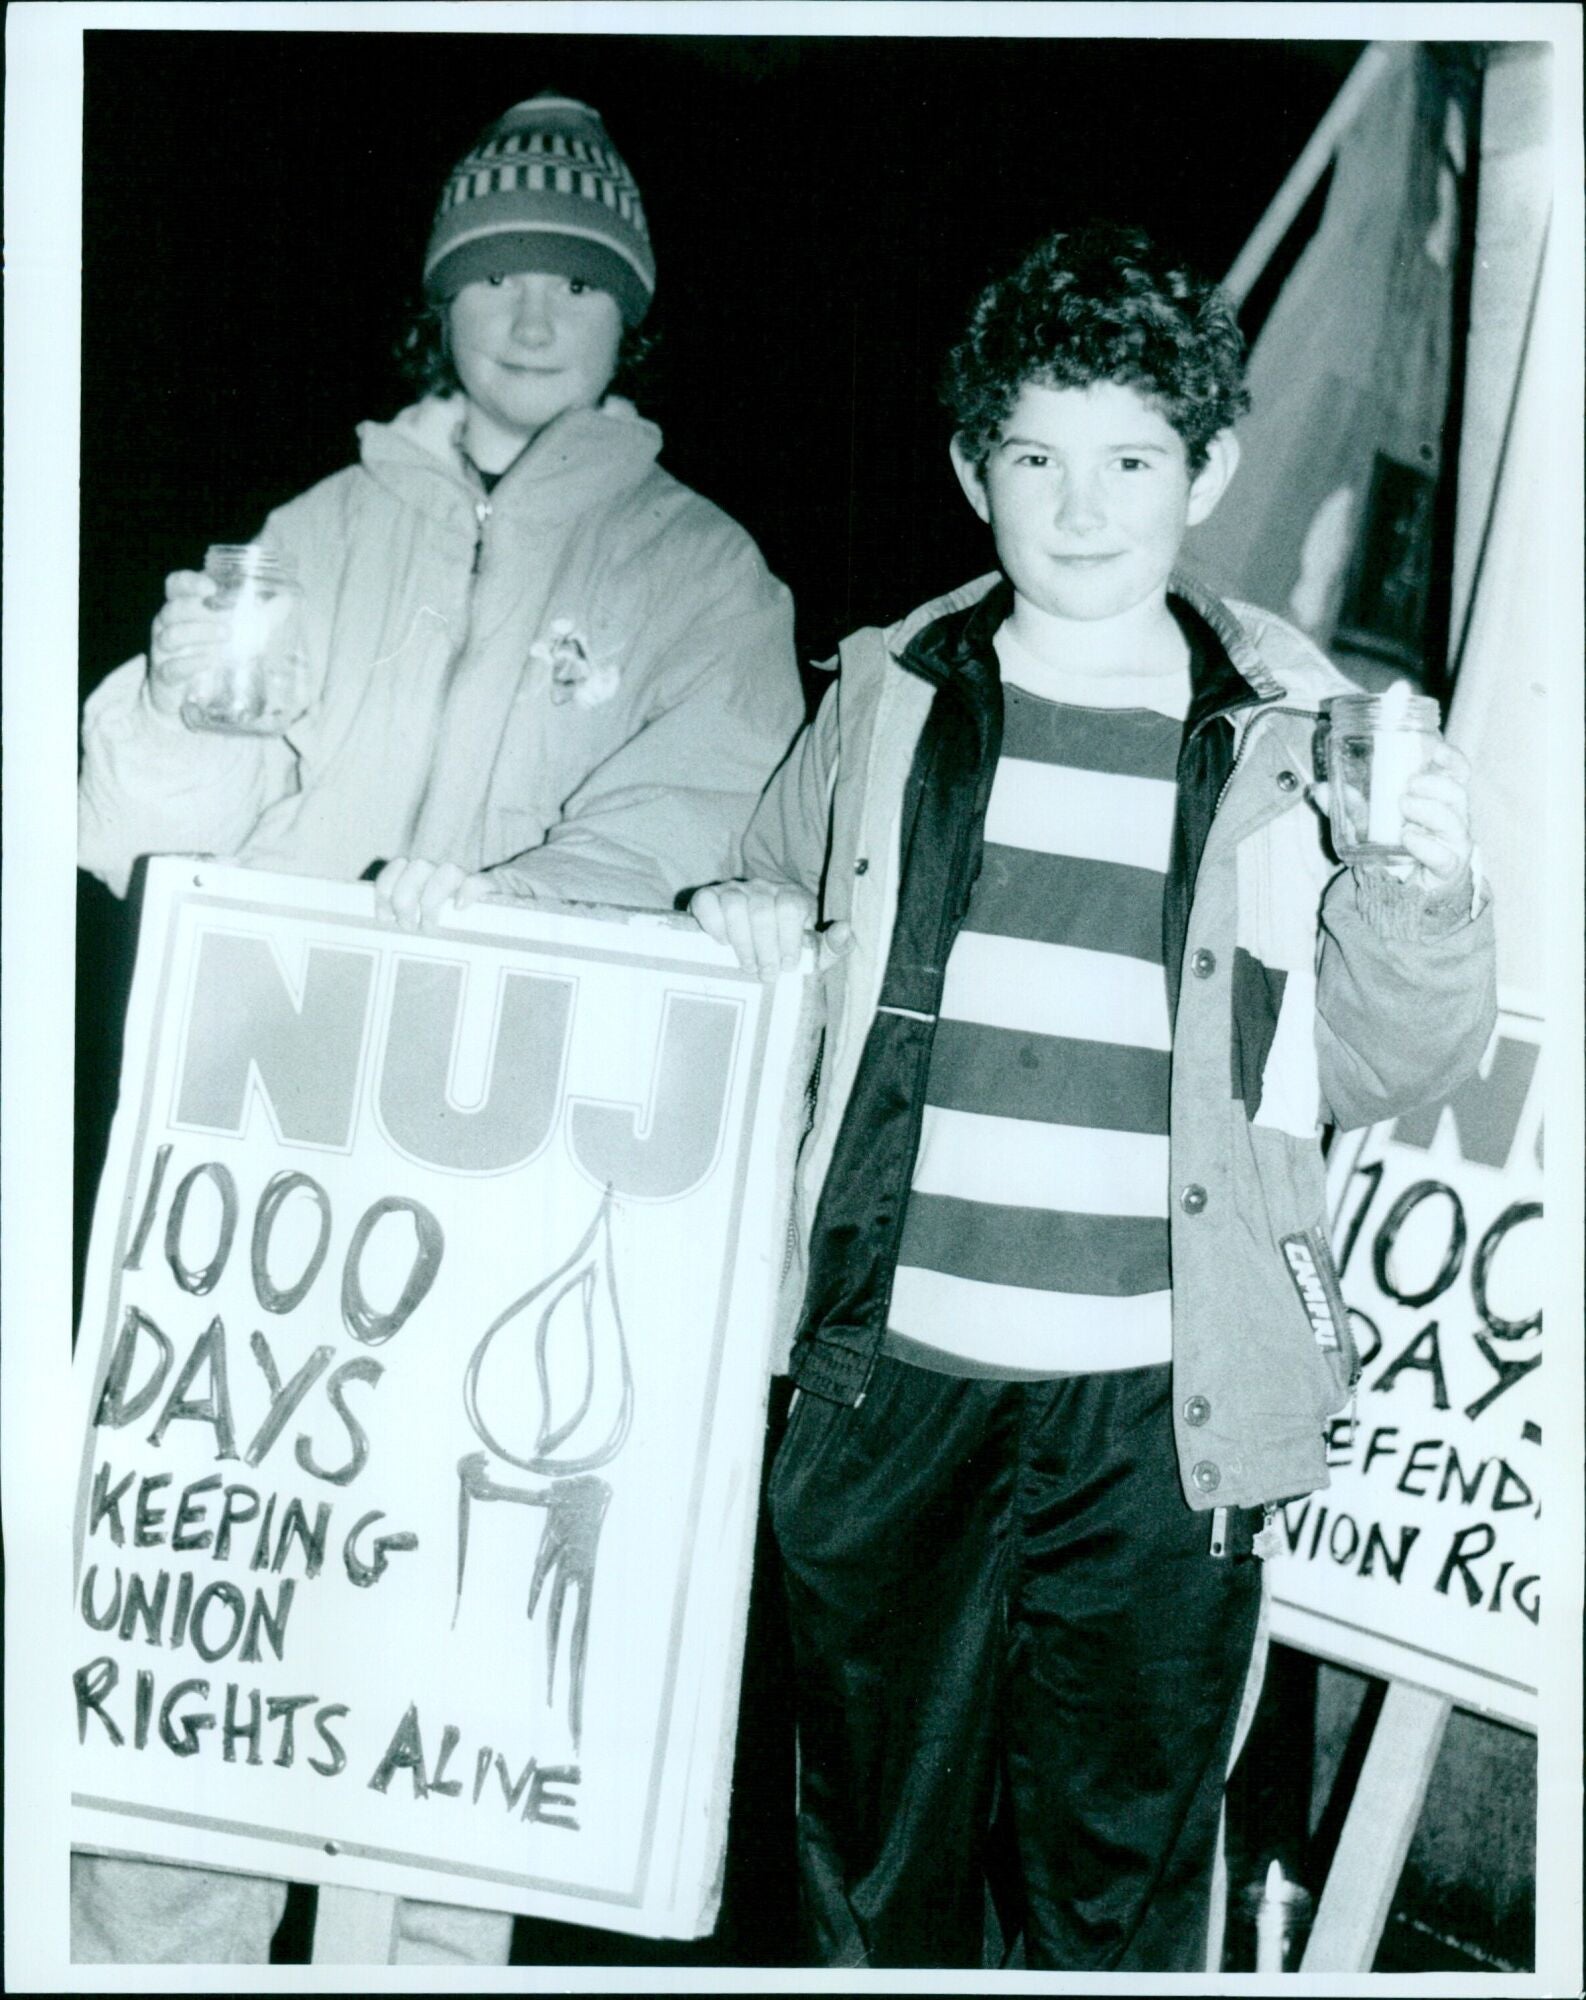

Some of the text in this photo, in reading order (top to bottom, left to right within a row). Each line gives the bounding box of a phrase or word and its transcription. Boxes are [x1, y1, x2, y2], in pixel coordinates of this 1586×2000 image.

[166, 925, 747, 1204] NUJ
[120, 1143, 445, 1347] 1000
[93, 1305, 385, 1487] DAYS
[1346, 1306, 1542, 1446] DAY
[89, 1461, 419, 1587] KEEPING
[1322, 1418, 1542, 1519] EFEND
[1279, 1500, 1420, 1585] NION
[80, 1564, 298, 1663] UNION
[71, 1655, 581, 1831] RIGHTS ALIVE
